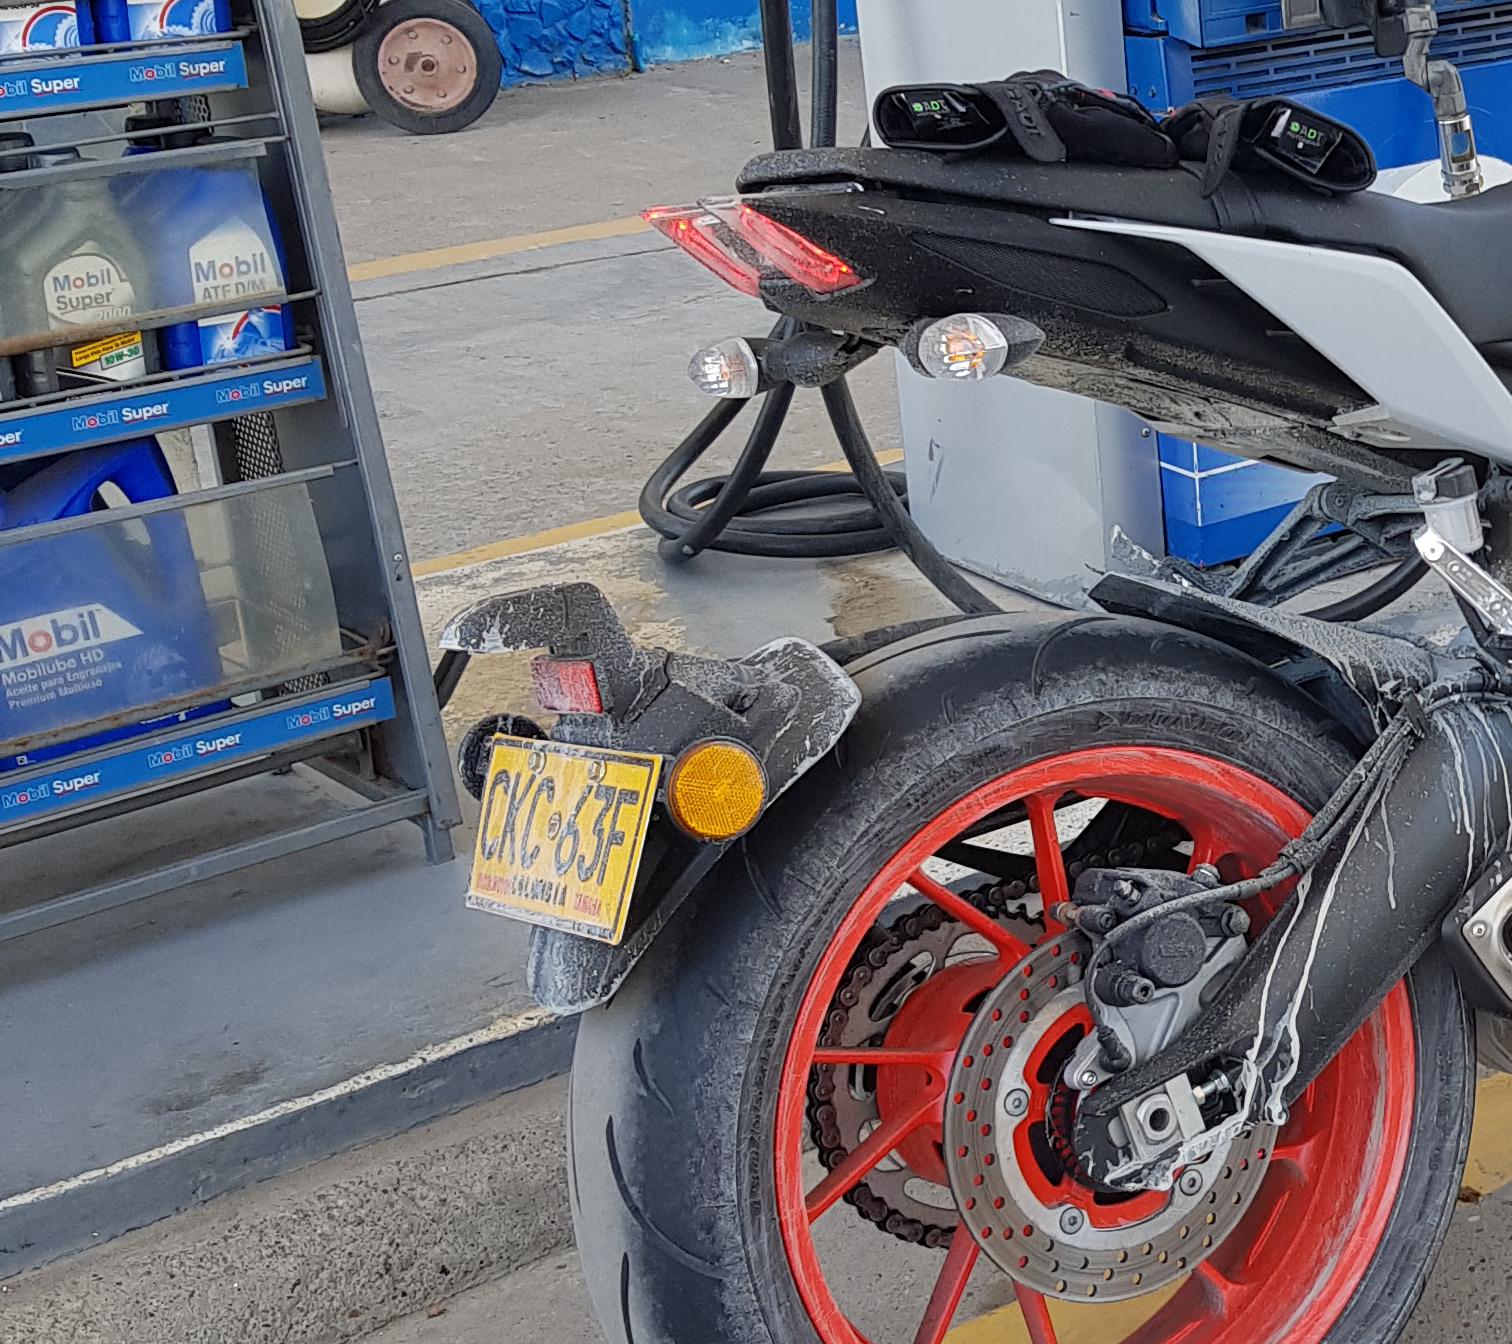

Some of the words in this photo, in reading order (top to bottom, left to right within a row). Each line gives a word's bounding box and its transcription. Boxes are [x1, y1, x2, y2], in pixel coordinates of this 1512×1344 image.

[130, 63, 176, 84] Mobil
[179, 59, 226, 77] Super
[31, 76, 81, 95] Super
[53, 268, 112, 293] Mobil
[194, 252, 267, 283] Mobil
[56, 289, 113, 311] Super
[202, 284, 231, 303] ATF
[104, 346, 140, 366] 10W-30
[216, 384, 260, 404] Mobil
[263, 376, 308, 396] Super
[72, 412, 119, 431] Mobil
[122, 404, 169, 423] Super
[0, 611, 100, 663] Mobil
[2, 659, 77, 687] Mobilube
[80, 648, 104, 666] HD
[6, 682, 39, 699] Aceite
[41, 677, 65, 694] para
[287, 706, 330, 730] Mobil
[333, 696, 377, 718] Super
[147, 744, 193, 768] Mobil
[196, 733, 242, 756] Super
[2, 783, 50, 808] Mobil
[52, 771, 101, 795] Super
